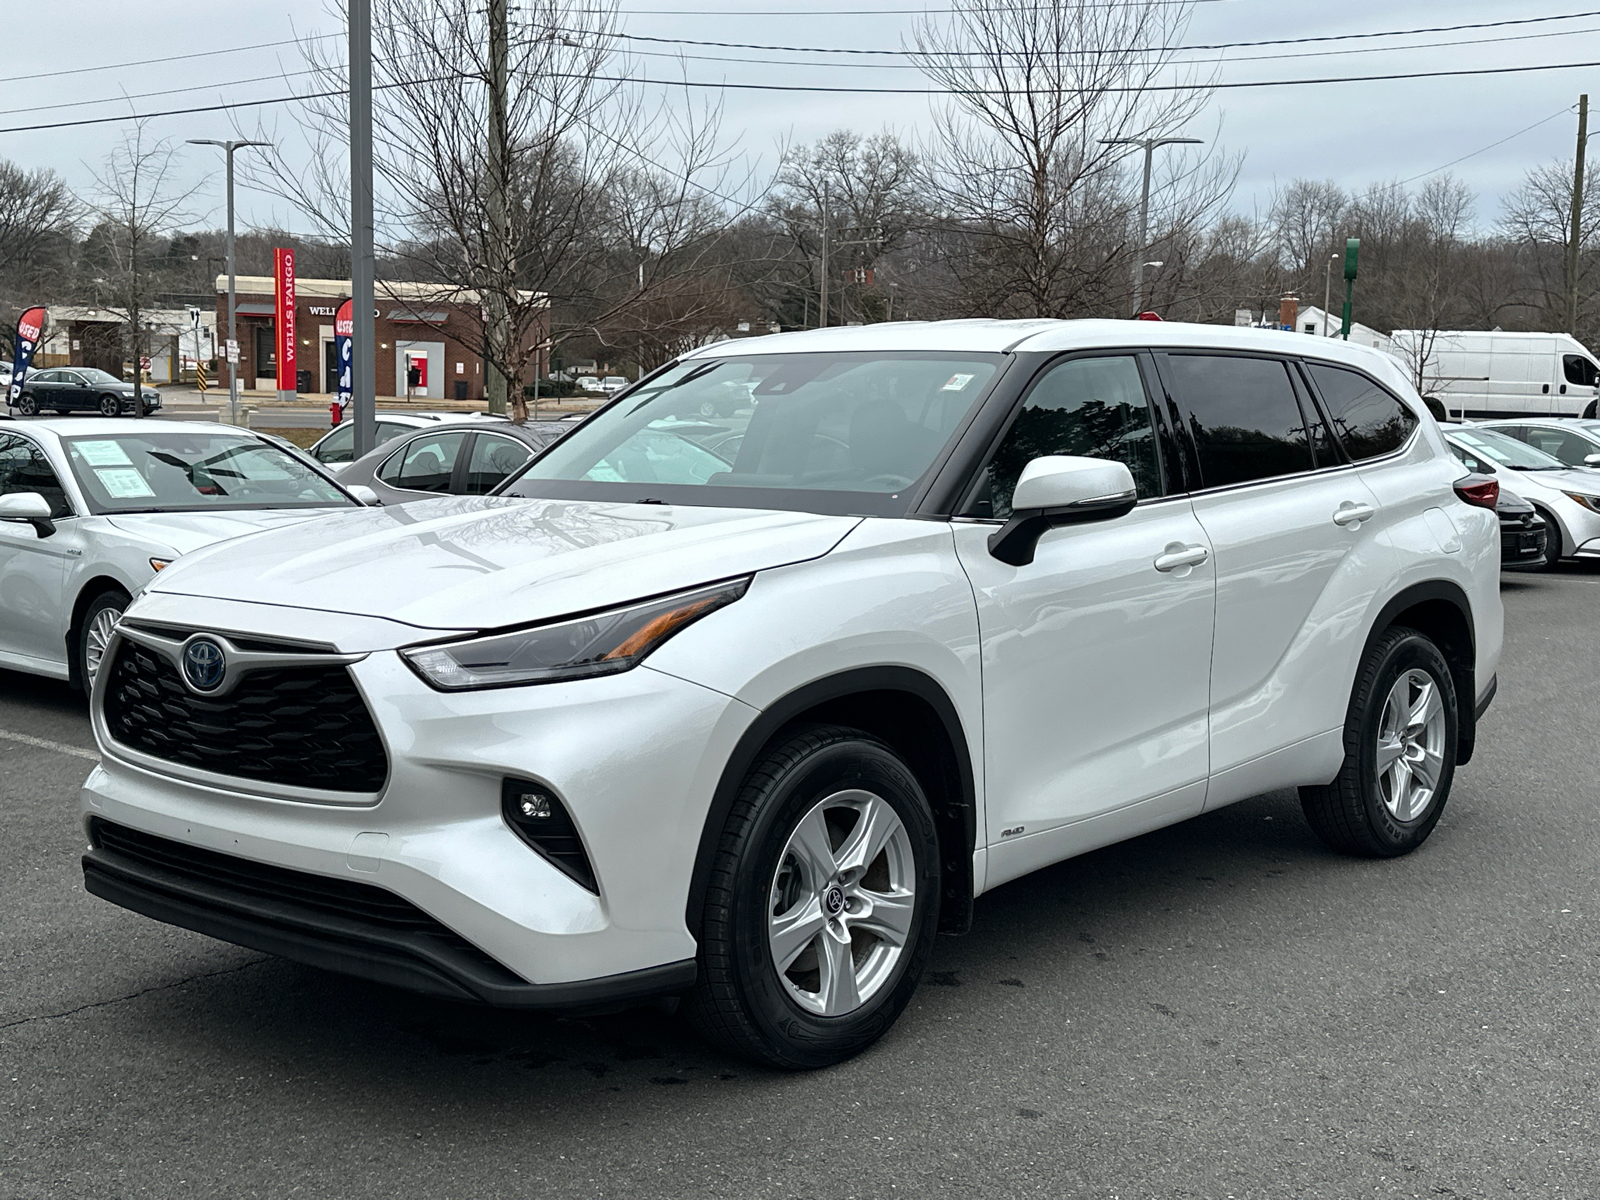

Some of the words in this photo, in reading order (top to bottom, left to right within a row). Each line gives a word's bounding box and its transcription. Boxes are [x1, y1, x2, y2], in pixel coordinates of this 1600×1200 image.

[284, 254, 294, 306] FARGO
[309, 306, 336, 316] WELL
[18, 321, 40, 339] USED
[285, 309, 295, 362] WELLS
